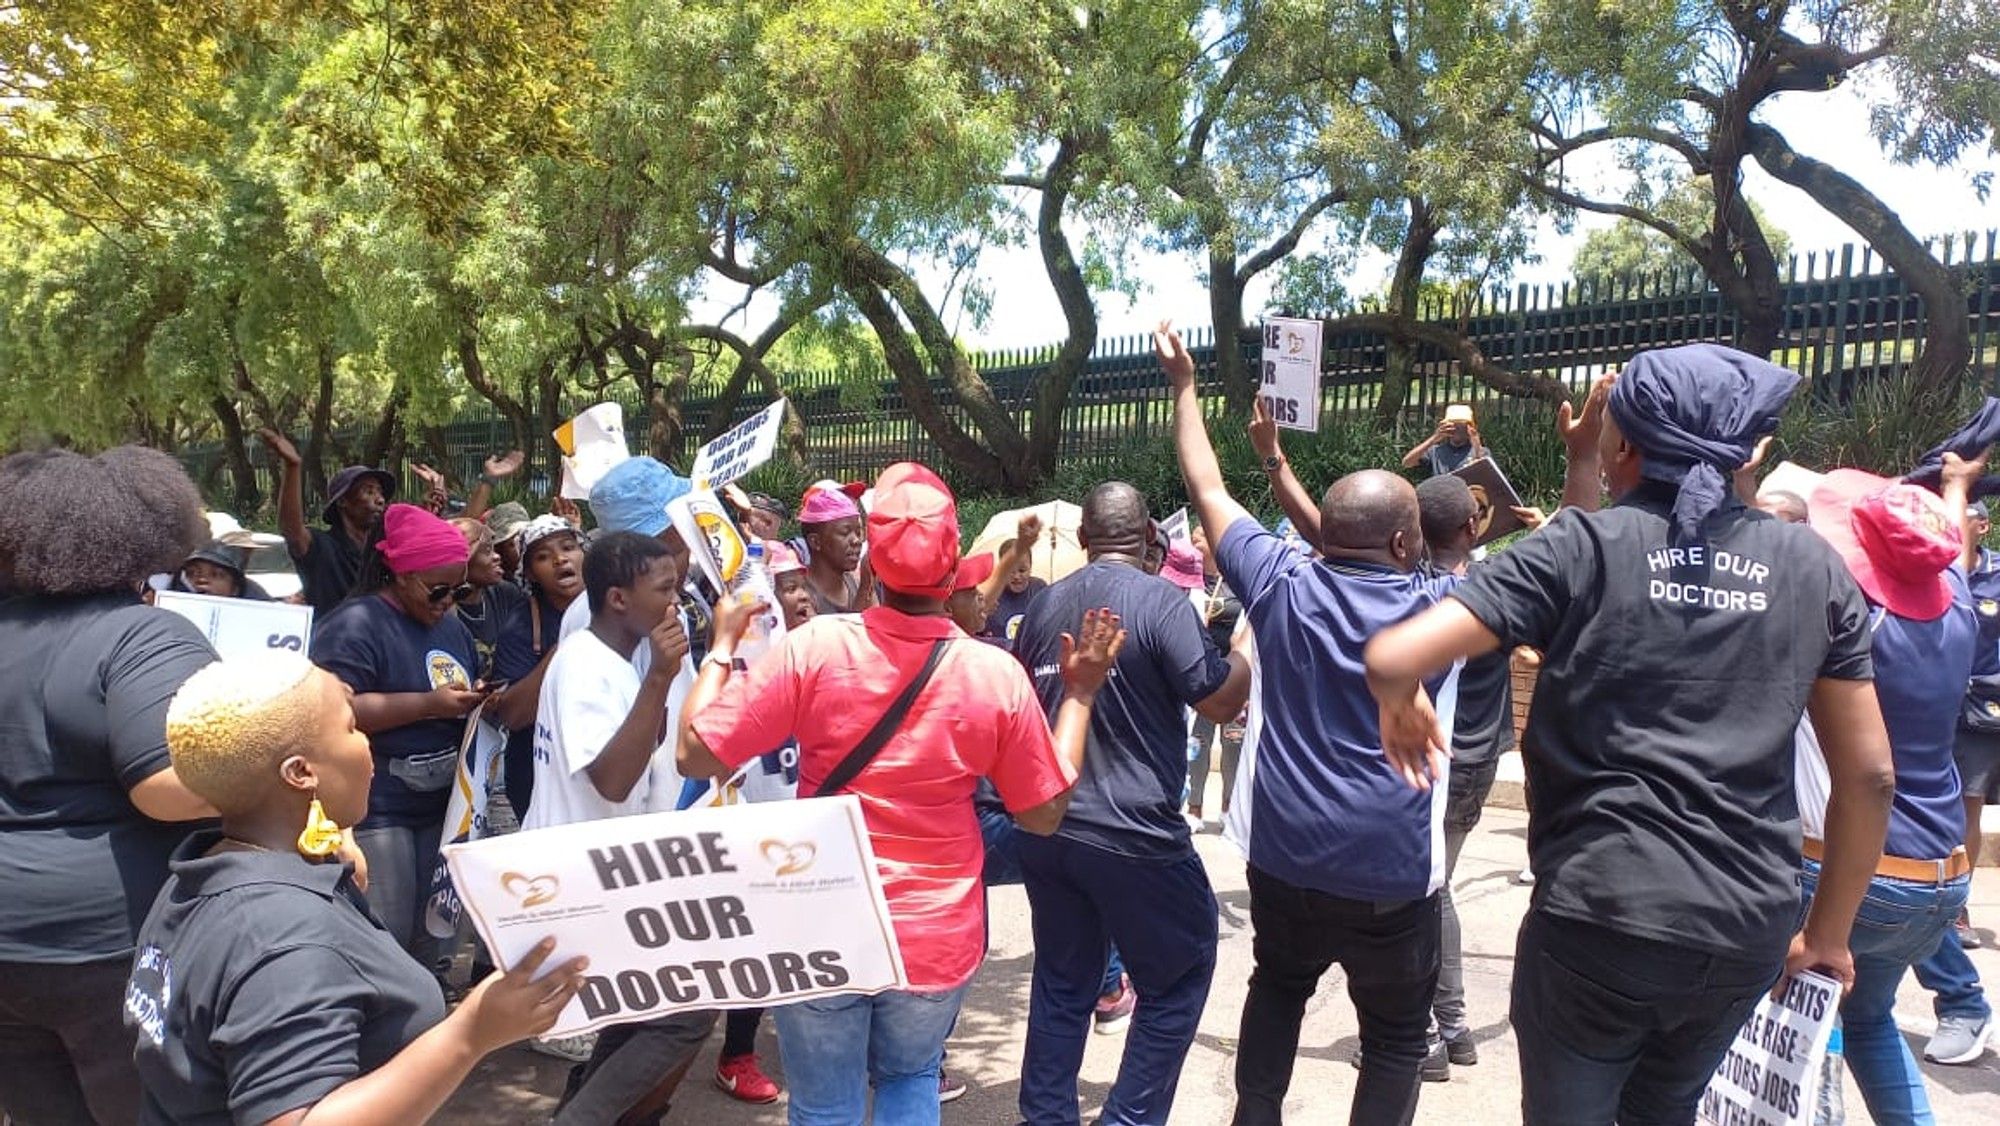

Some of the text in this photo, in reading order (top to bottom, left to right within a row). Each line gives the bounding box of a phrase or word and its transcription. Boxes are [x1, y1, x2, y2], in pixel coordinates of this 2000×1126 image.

[707, 408, 770, 458] DOCTORS
[710, 435, 758, 474] JOB OR
[1647, 546, 1770, 585] HIRE OUR
[1650, 579, 1767, 612] DOCTORS
[587, 831, 738, 892] HIRE
[625, 895, 754, 949] OUR
[578, 950, 849, 1021] DOCTORS
[1774, 978, 1830, 1022] ENTS
[1761, 1018, 1799, 1063] RISE
[1761, 1069, 1801, 1120] JOBS
